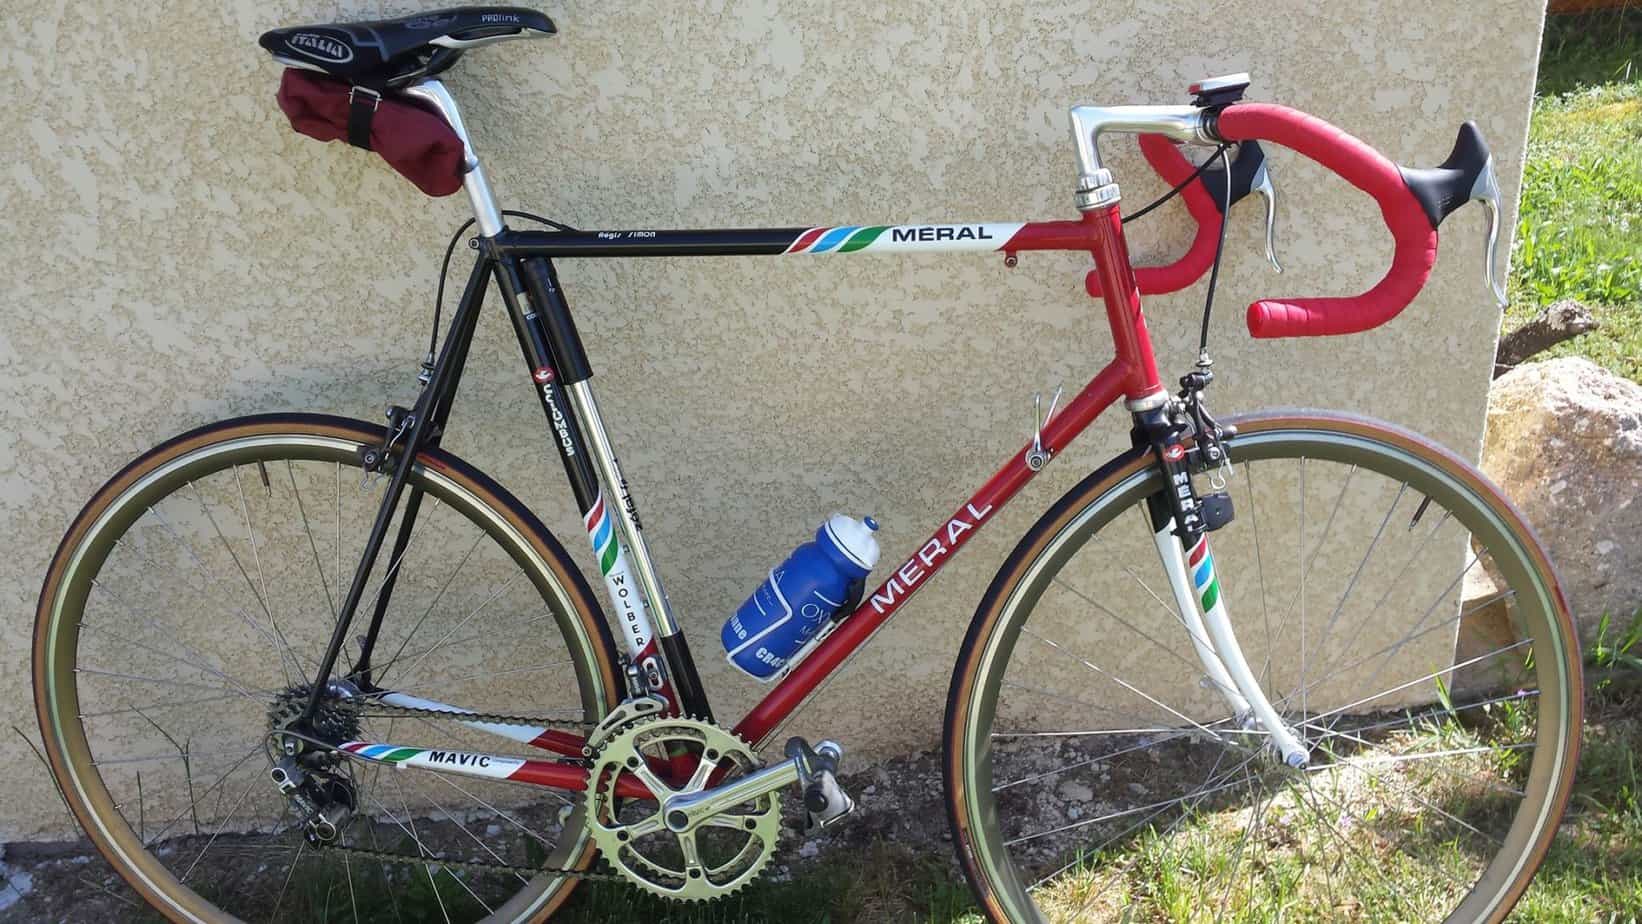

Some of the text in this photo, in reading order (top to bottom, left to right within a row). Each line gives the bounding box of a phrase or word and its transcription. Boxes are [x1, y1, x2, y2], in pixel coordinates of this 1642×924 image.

[291, 34, 343, 58] ITALIA
[870, 503, 993, 614] MERAL
[612, 575, 646, 647] WOLBER
[428, 751, 491, 768] MAVIC
